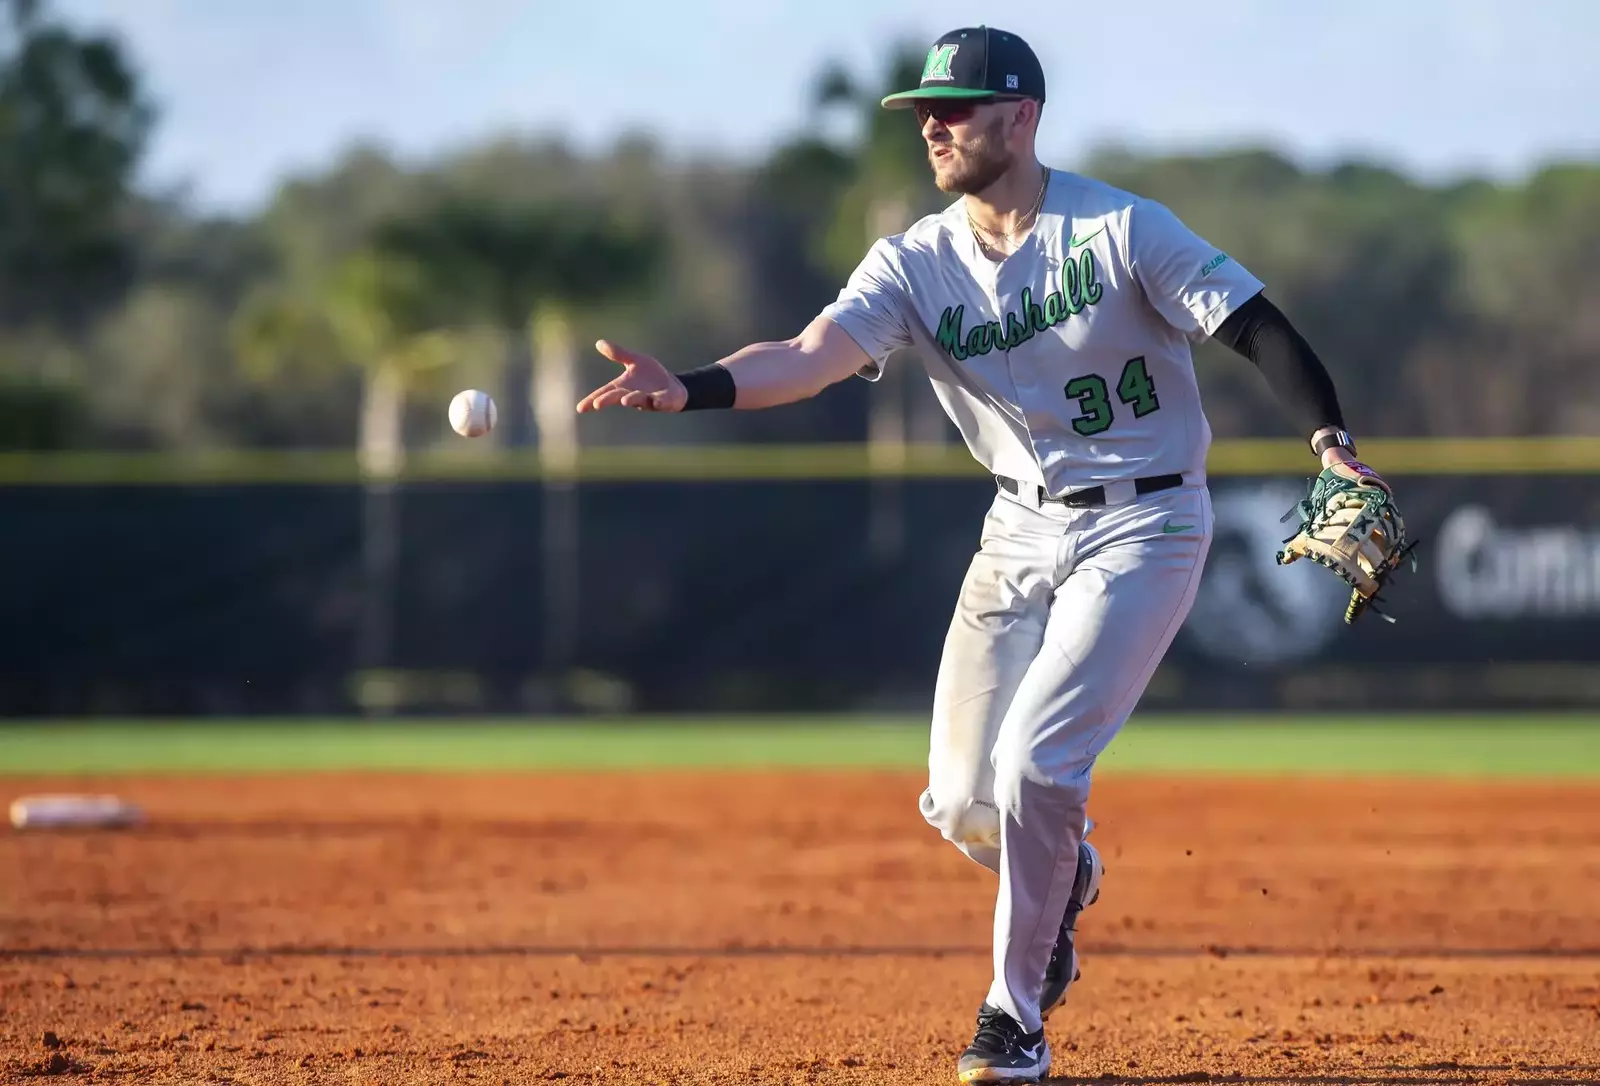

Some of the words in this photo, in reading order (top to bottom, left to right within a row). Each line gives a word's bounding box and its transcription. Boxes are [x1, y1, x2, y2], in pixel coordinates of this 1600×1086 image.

[921, 43, 960, 83] M
[935, 248, 1103, 361] Marshall
[1064, 355, 1160, 436] 34
